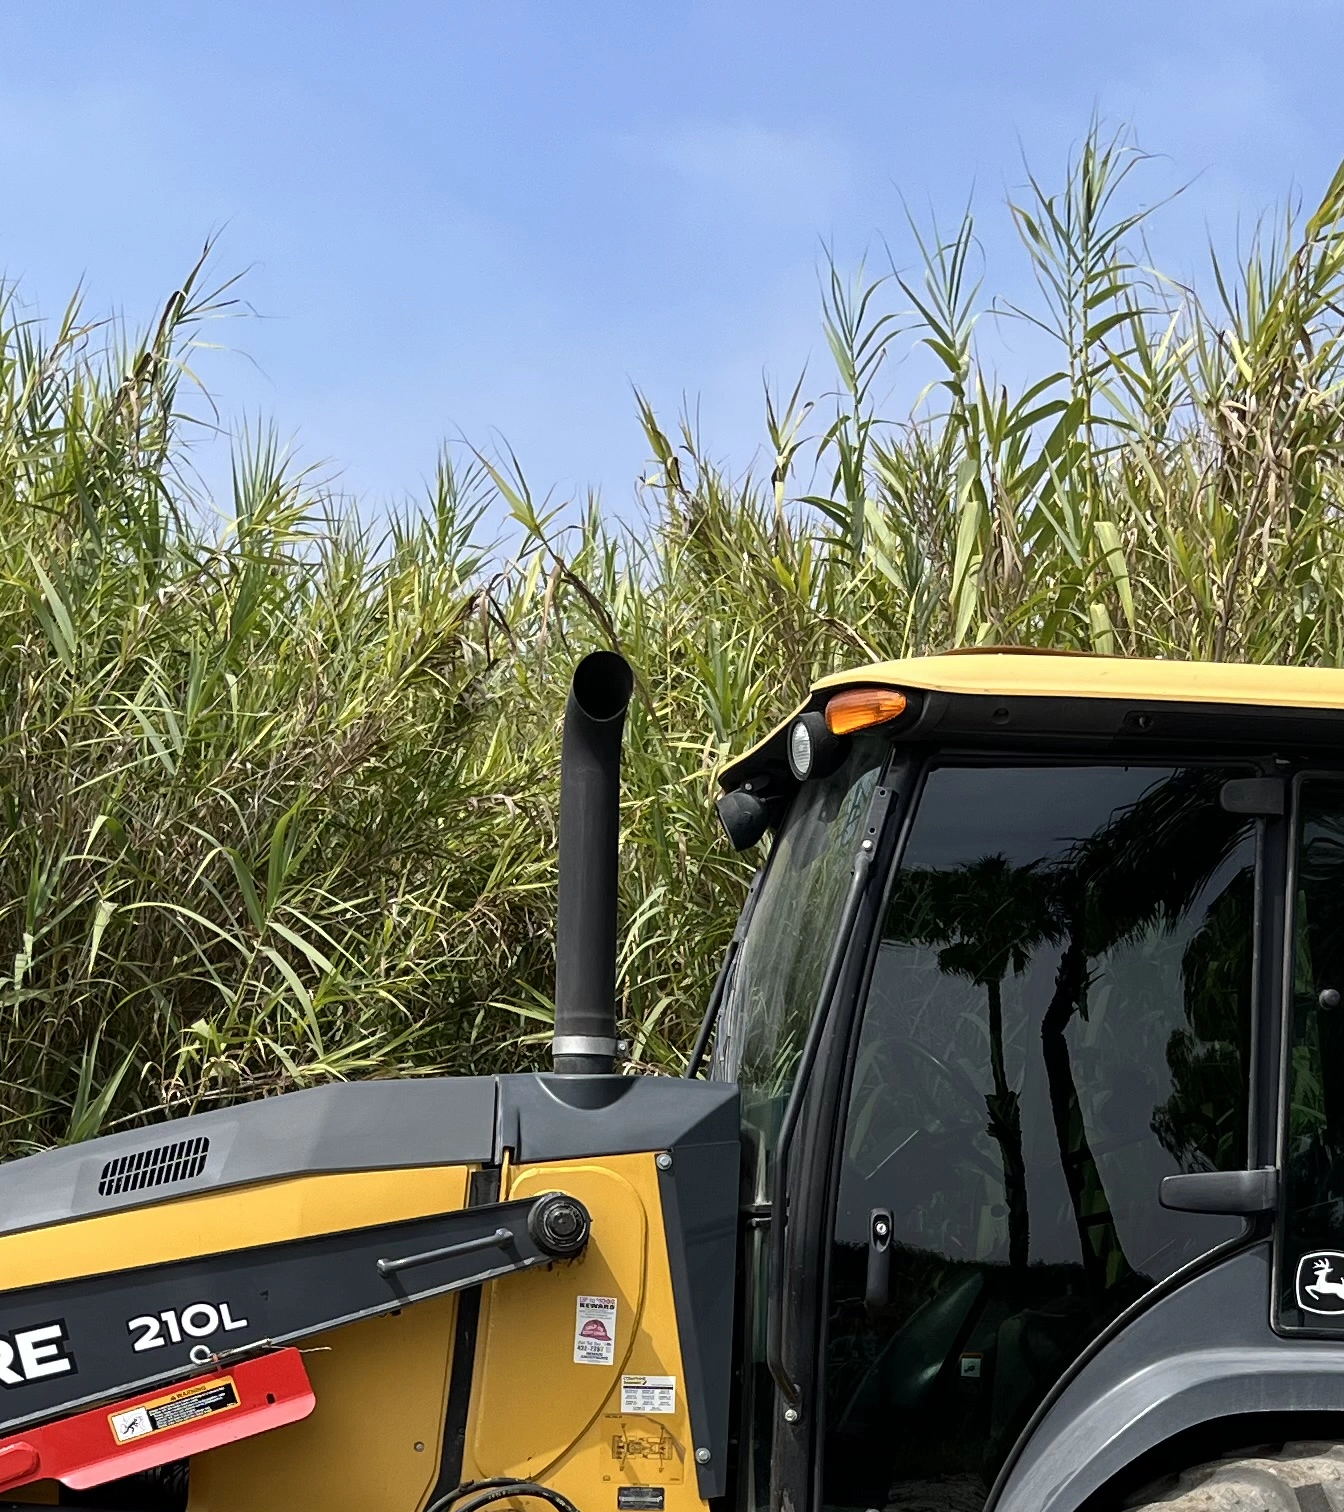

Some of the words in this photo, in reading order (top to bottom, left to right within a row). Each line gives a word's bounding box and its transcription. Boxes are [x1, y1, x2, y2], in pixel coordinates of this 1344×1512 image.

[579, 1302, 615, 1310] REWARD
[128, 1302, 248, 1351] 210L
[176, 1385, 207, 1399] WARNING
